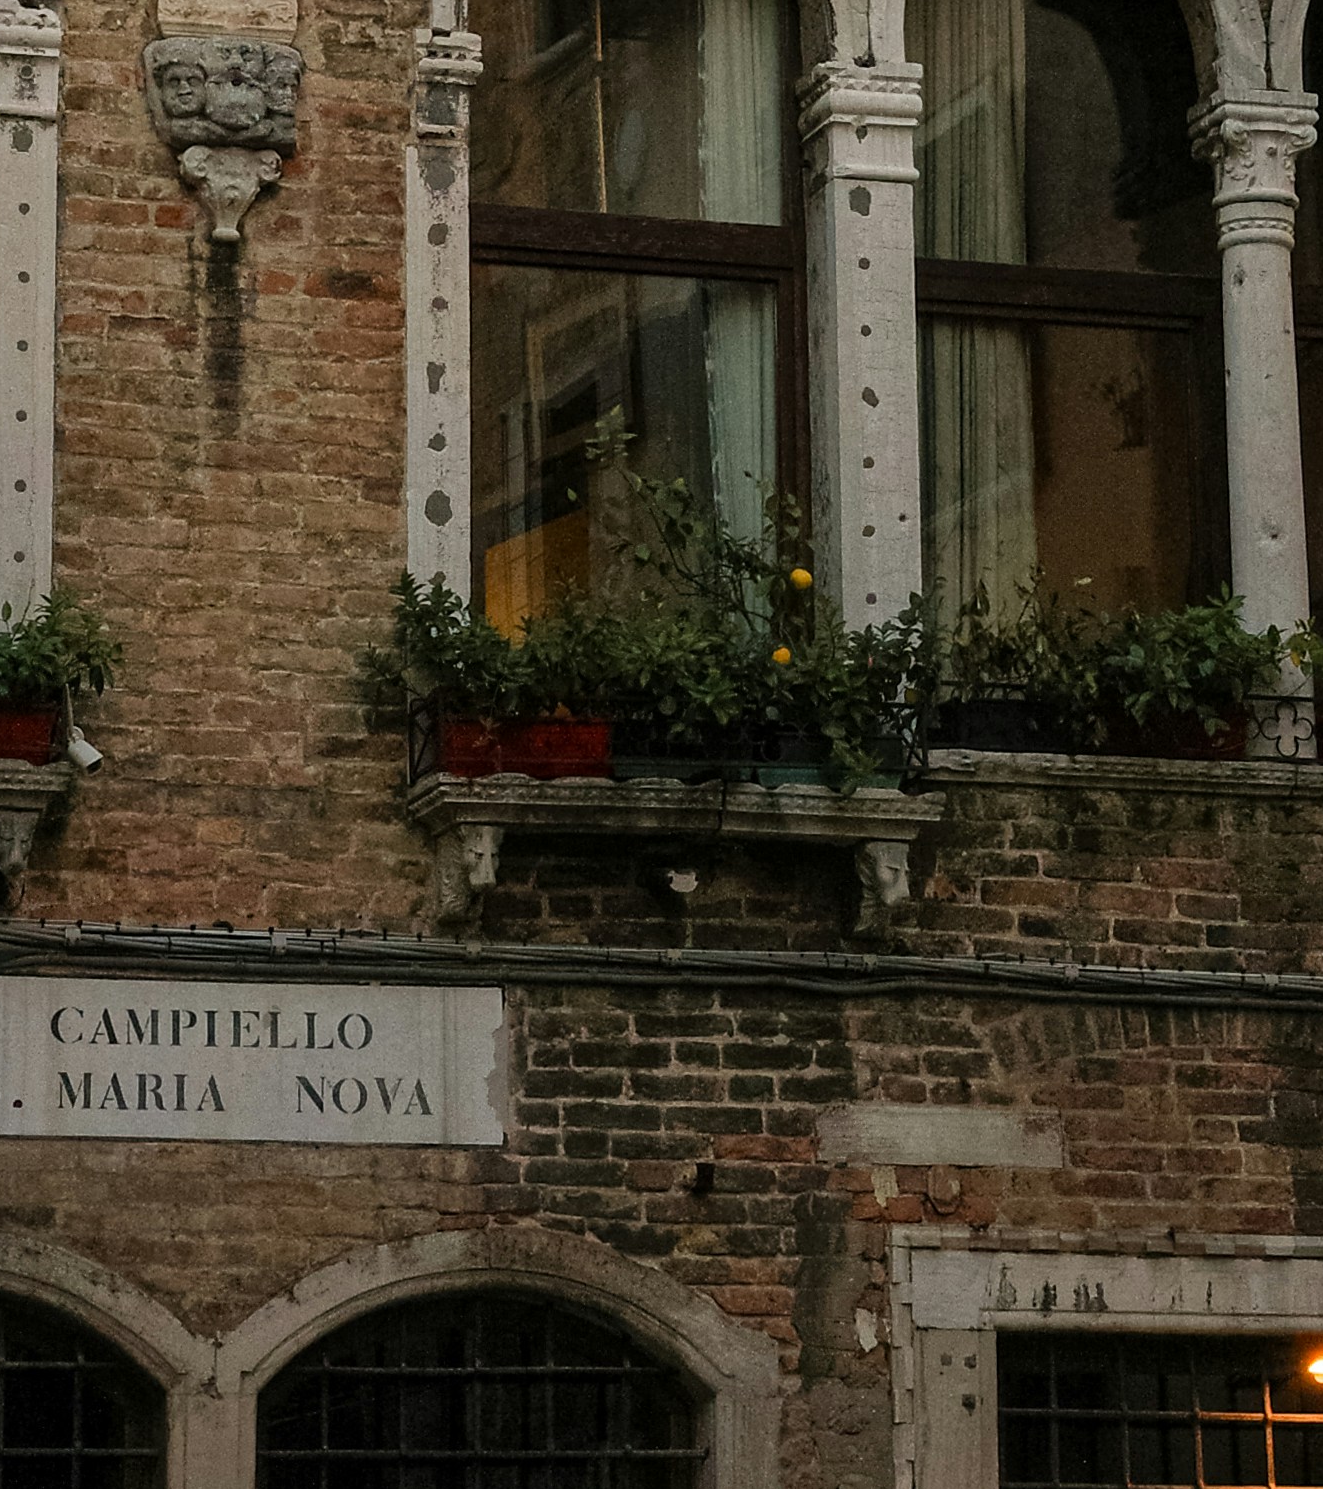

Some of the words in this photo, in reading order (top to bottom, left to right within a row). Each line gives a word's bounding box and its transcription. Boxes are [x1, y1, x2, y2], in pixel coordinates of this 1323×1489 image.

[50, 1006, 374, 1050] CAMPIELLO
[57, 1071, 226, 1112] MARIA
[295, 1075, 434, 1117] NOVA
